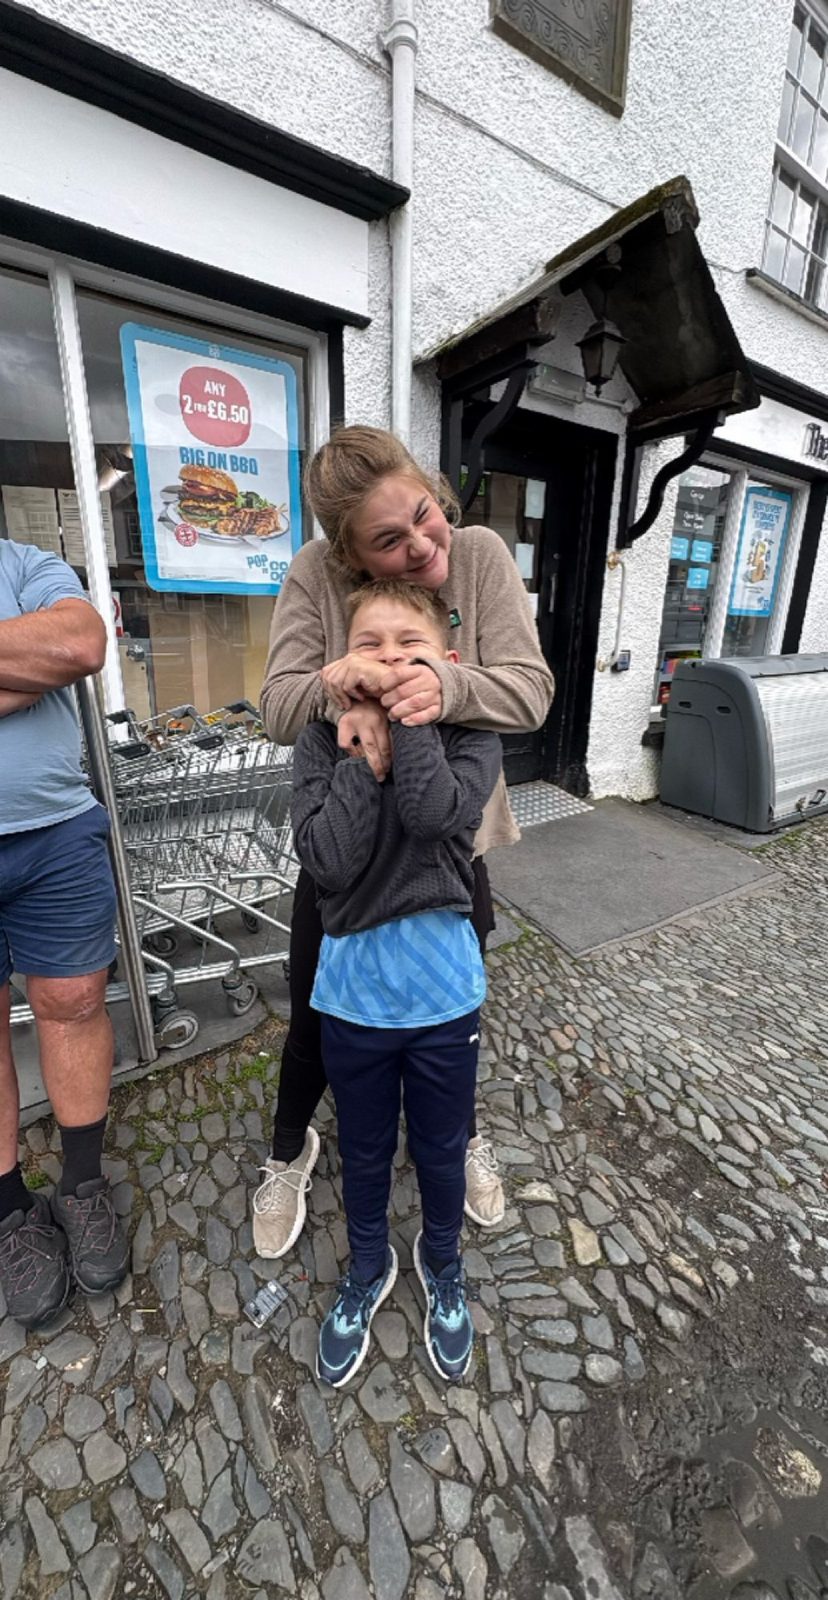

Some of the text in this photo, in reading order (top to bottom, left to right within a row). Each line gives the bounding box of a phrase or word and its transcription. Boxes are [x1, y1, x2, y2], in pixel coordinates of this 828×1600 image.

[203, 380, 227, 397] ANY
[182, 394, 194, 414] 2
[207, 399, 249, 425] £6.50
[179, 446, 259, 476] BIG ON BBQ
[246, 554, 269, 569] POP
